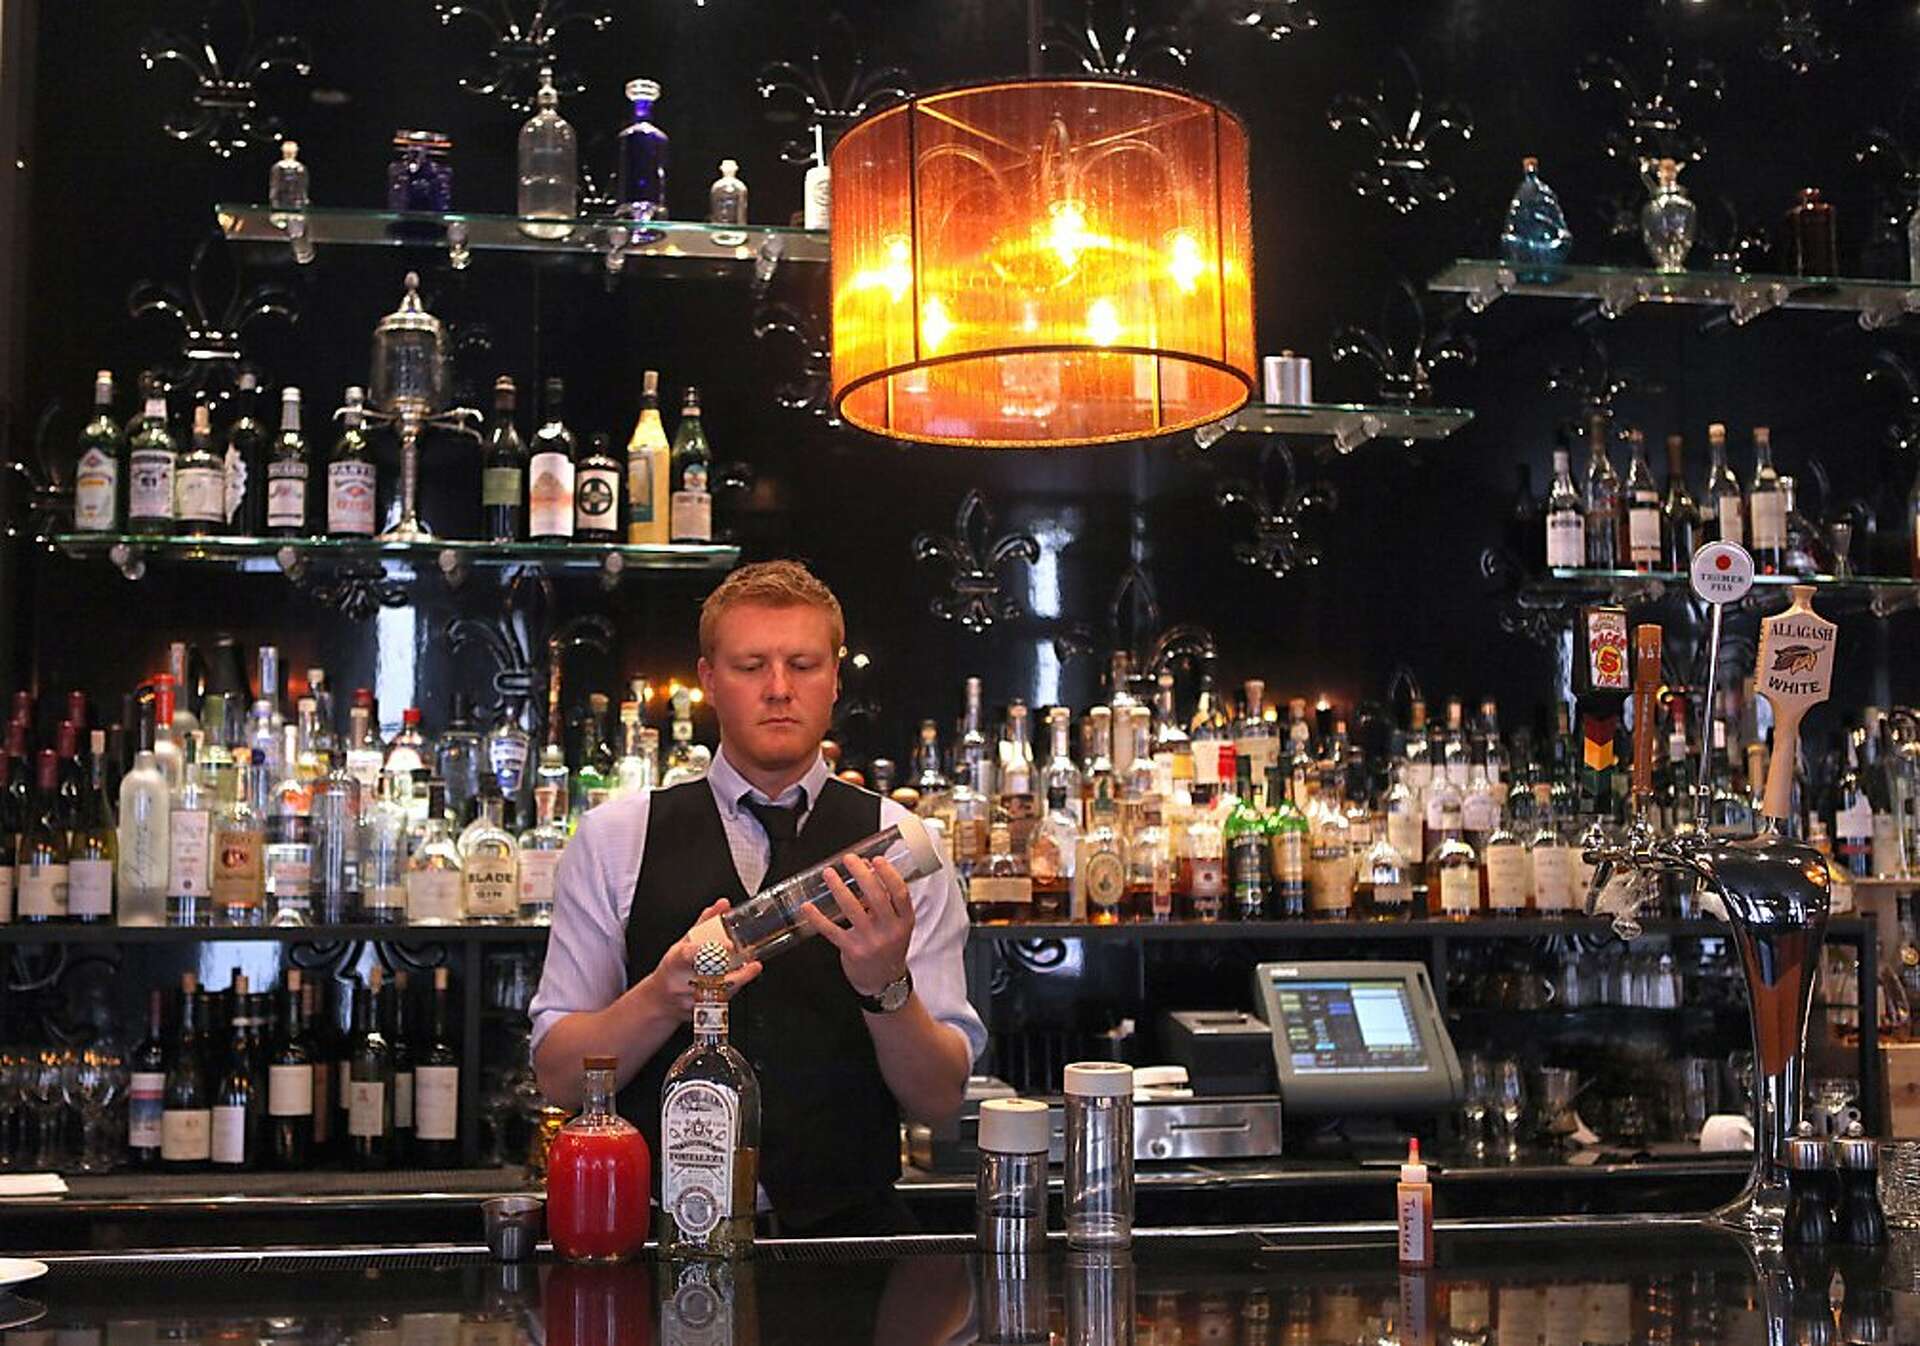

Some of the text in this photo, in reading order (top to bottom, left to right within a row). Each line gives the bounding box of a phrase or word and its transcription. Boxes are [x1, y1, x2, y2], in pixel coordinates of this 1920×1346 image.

[1771, 622, 1833, 641] ALLAGASH
[1590, 631, 1628, 653] RACER
[1768, 676, 1822, 695] WHITE
